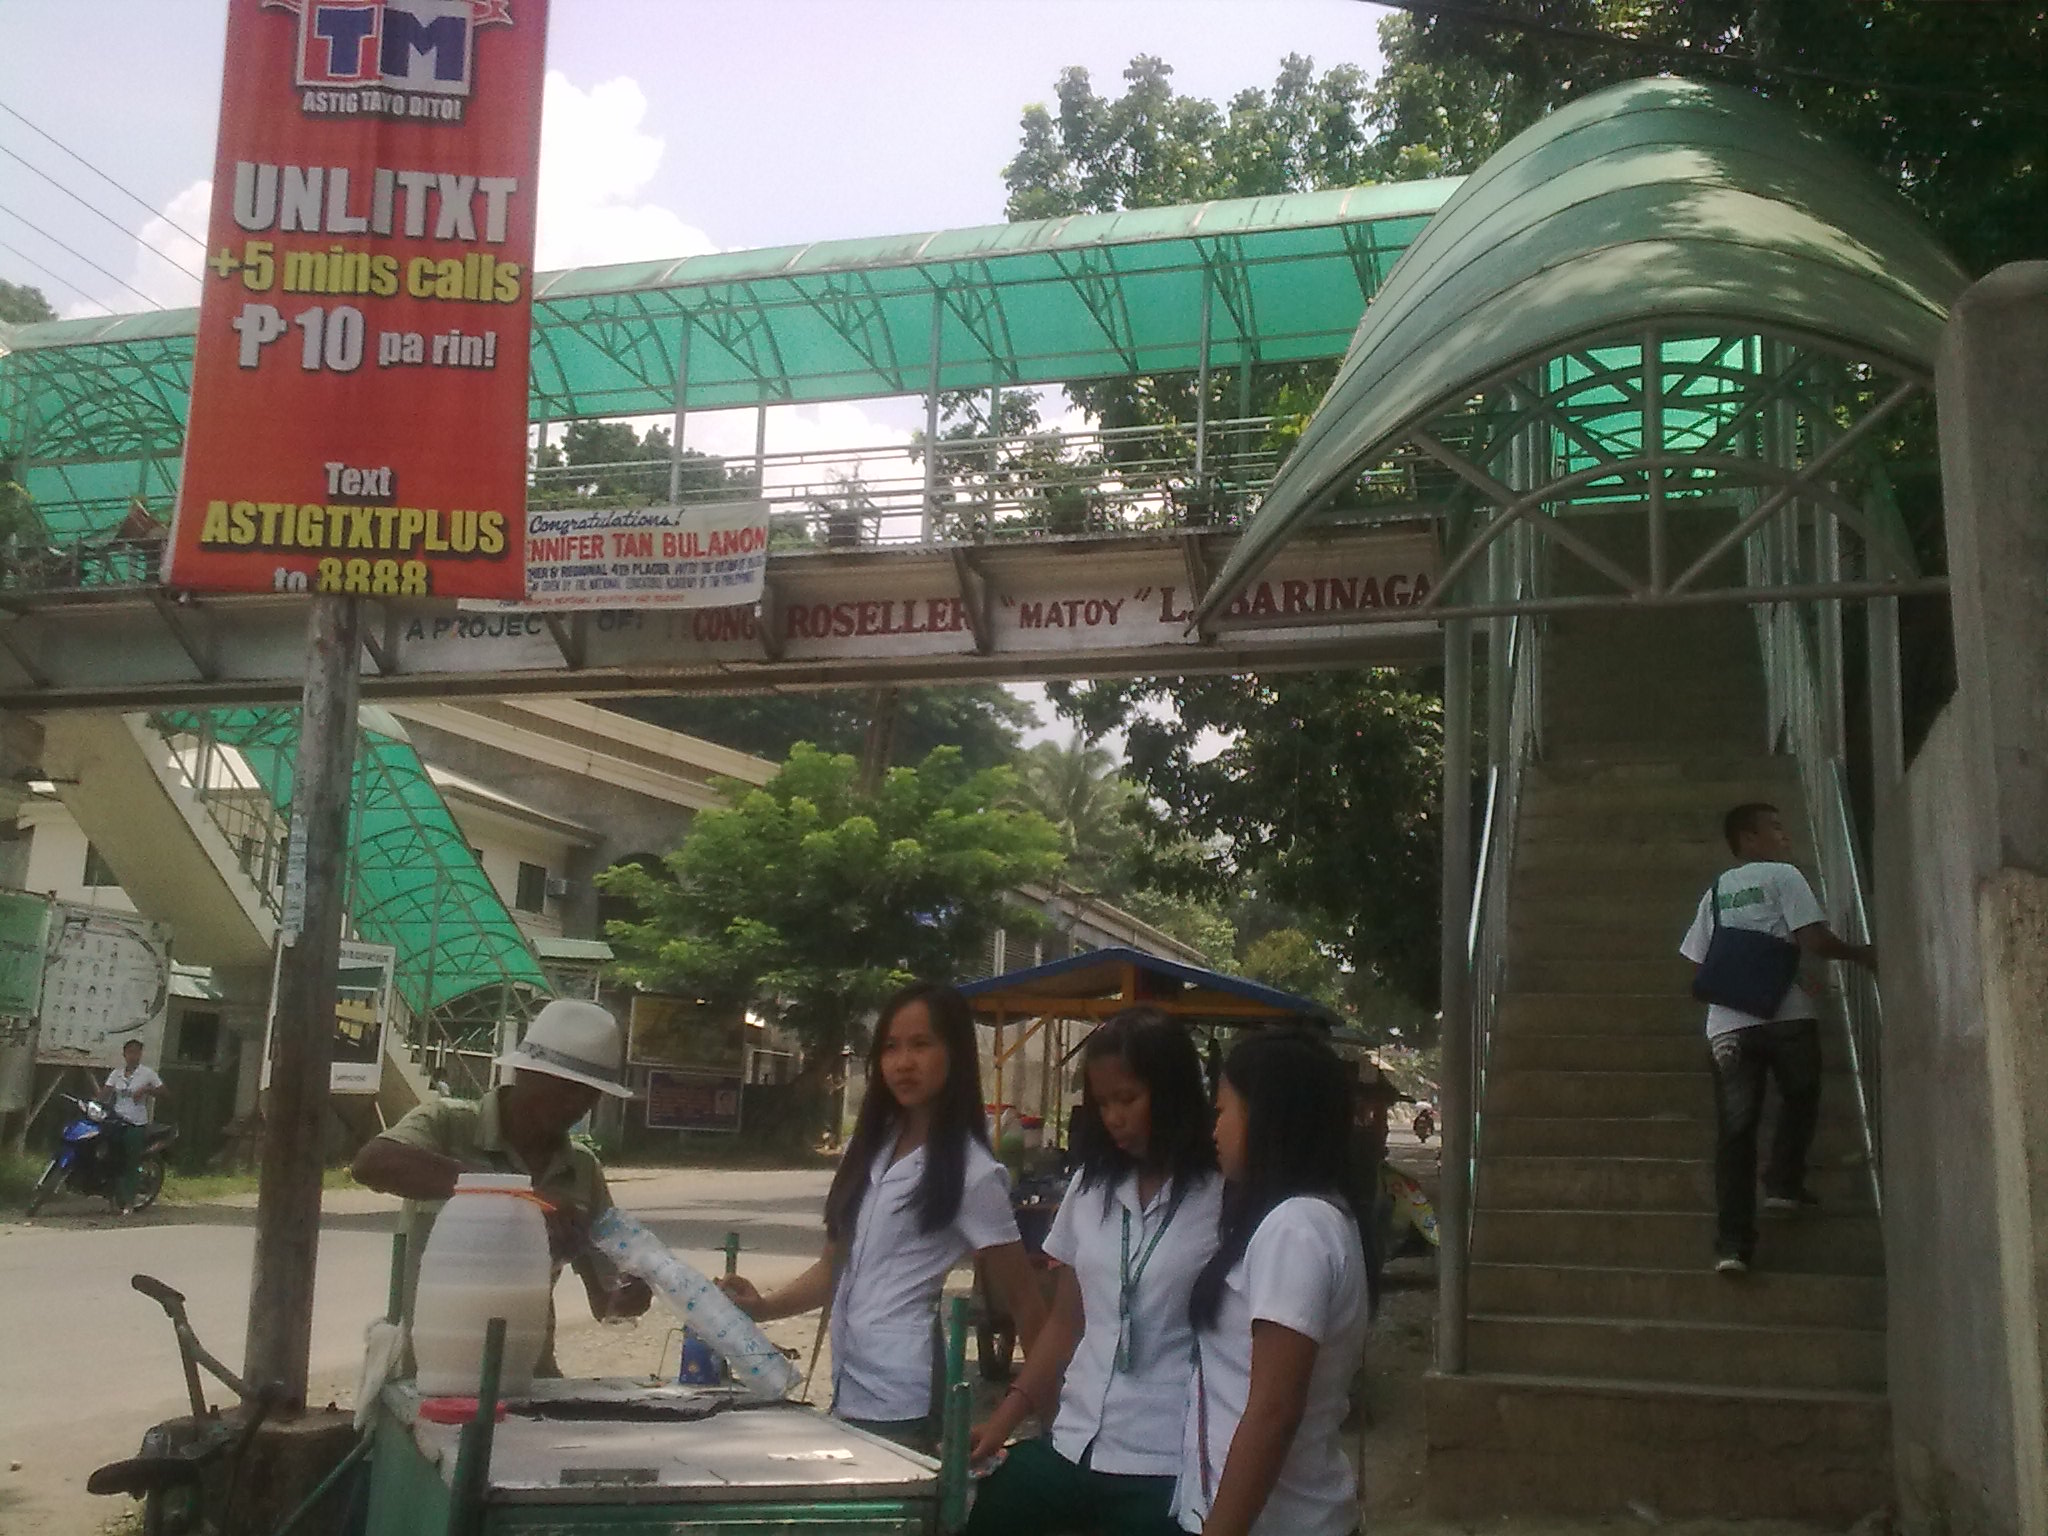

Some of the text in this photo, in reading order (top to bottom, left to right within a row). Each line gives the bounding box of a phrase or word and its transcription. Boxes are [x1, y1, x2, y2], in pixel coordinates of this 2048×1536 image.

[315, 7, 466, 81] TM
[303, 91, 358, 113] ASTIG
[233, 161, 517, 243] UNLITXT
[207, 240, 521, 302] +5 mins calls
[378, 330, 424, 366] pa
[432, 329, 497, 367] rin!
[325, 462, 393, 497] Text
[201, 500, 504, 554] ASTIGTXTPLUS
[526, 534, 604, 561] NNIFER
[612, 532, 654, 558] TAN
[405, 614, 425, 642] A
[432, 612, 543, 640] PROJEC
